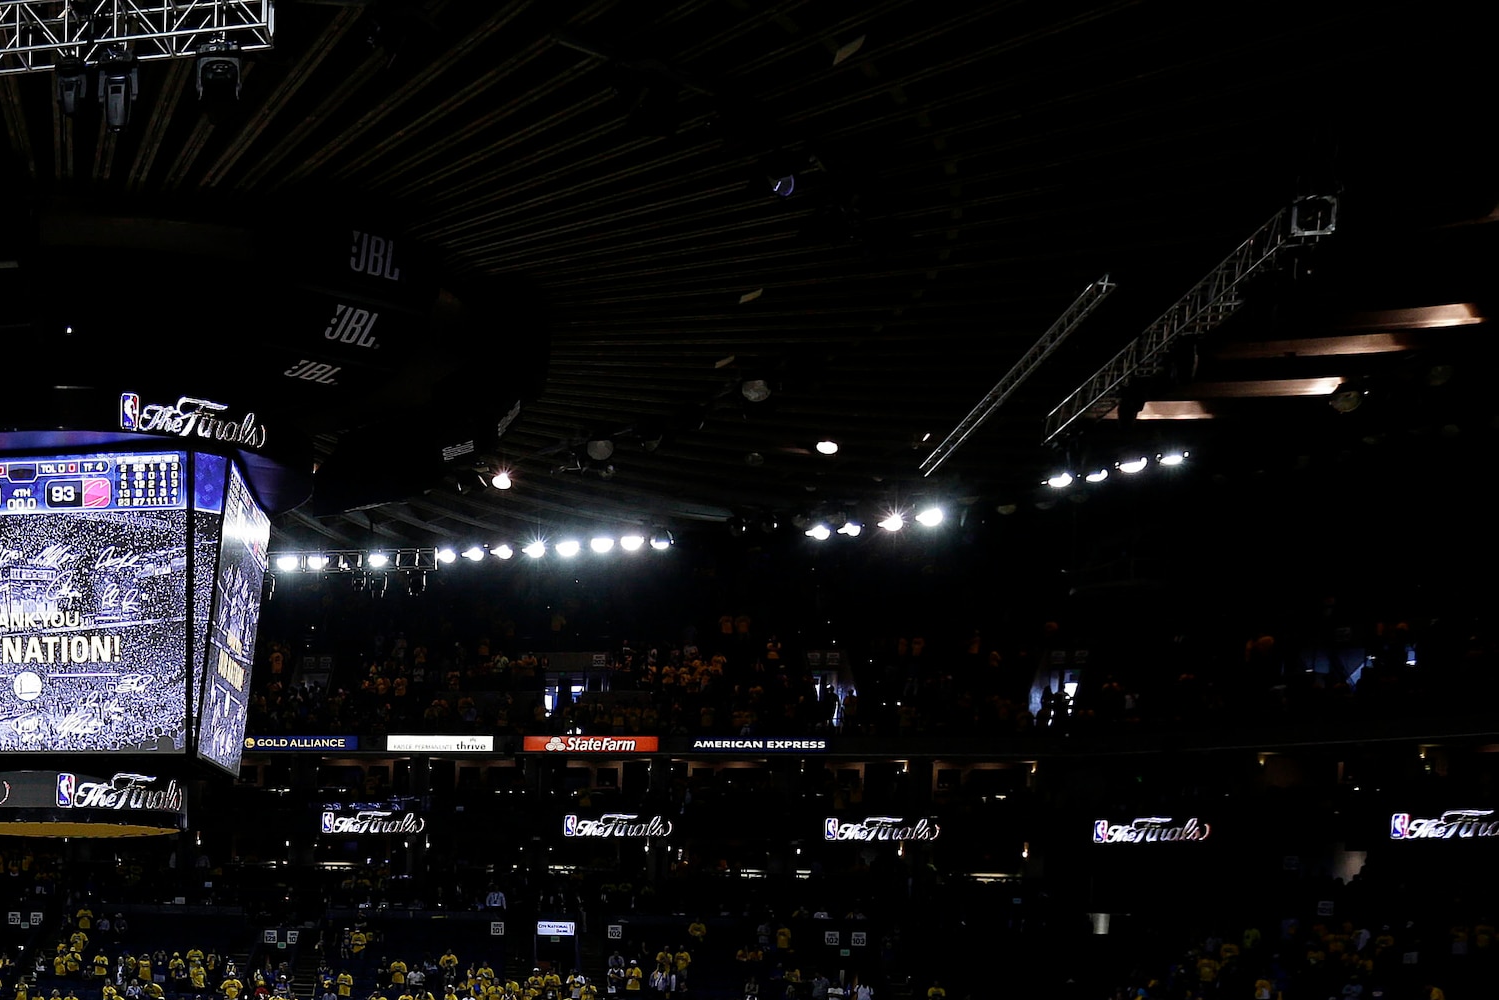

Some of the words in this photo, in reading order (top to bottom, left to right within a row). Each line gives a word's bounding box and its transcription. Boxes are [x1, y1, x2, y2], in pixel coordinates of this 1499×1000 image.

[350, 229, 400, 281] JBL
[324, 304, 379, 348] JBL
[284, 360, 342, 383] JBL
[139, 405, 182, 433] The
[176, 396, 267, 448] Finals
[41, 465, 57, 474] TOL
[58, 464, 65, 473] 0
[68, 464, 76, 472] 0
[83, 463, 93, 472] TF
[96, 462, 104, 471] 4
[6, 498, 36, 510] 00.0
[12, 488, 30, 498] 4TH
[52, 486, 74, 502] 93
[34, 612, 80, 628] YOU
[2, 635, 122, 664] NATION!
[256, 739, 288, 747] GOLD
[290, 738, 346, 748] ALLIANCE
[456, 741, 486, 750] thrive
[694, 740, 764, 749] AMERICAN
[767, 740, 826, 749] EXPRESS
[75, 782, 118, 808] The
[111, 774, 182, 810] Finals
[334, 818, 361, 834] The
[357, 811, 426, 836] Finals
[576, 820, 604, 836] The
[600, 813, 673, 838] Finals
[839, 825, 868, 841] The
[862, 817, 940, 842] Finals
[1107, 825, 1137, 843] The
[1132, 816, 1211, 844] Finals
[1407, 819, 1446, 838] The
[1440, 810, 1499, 840] Fina
